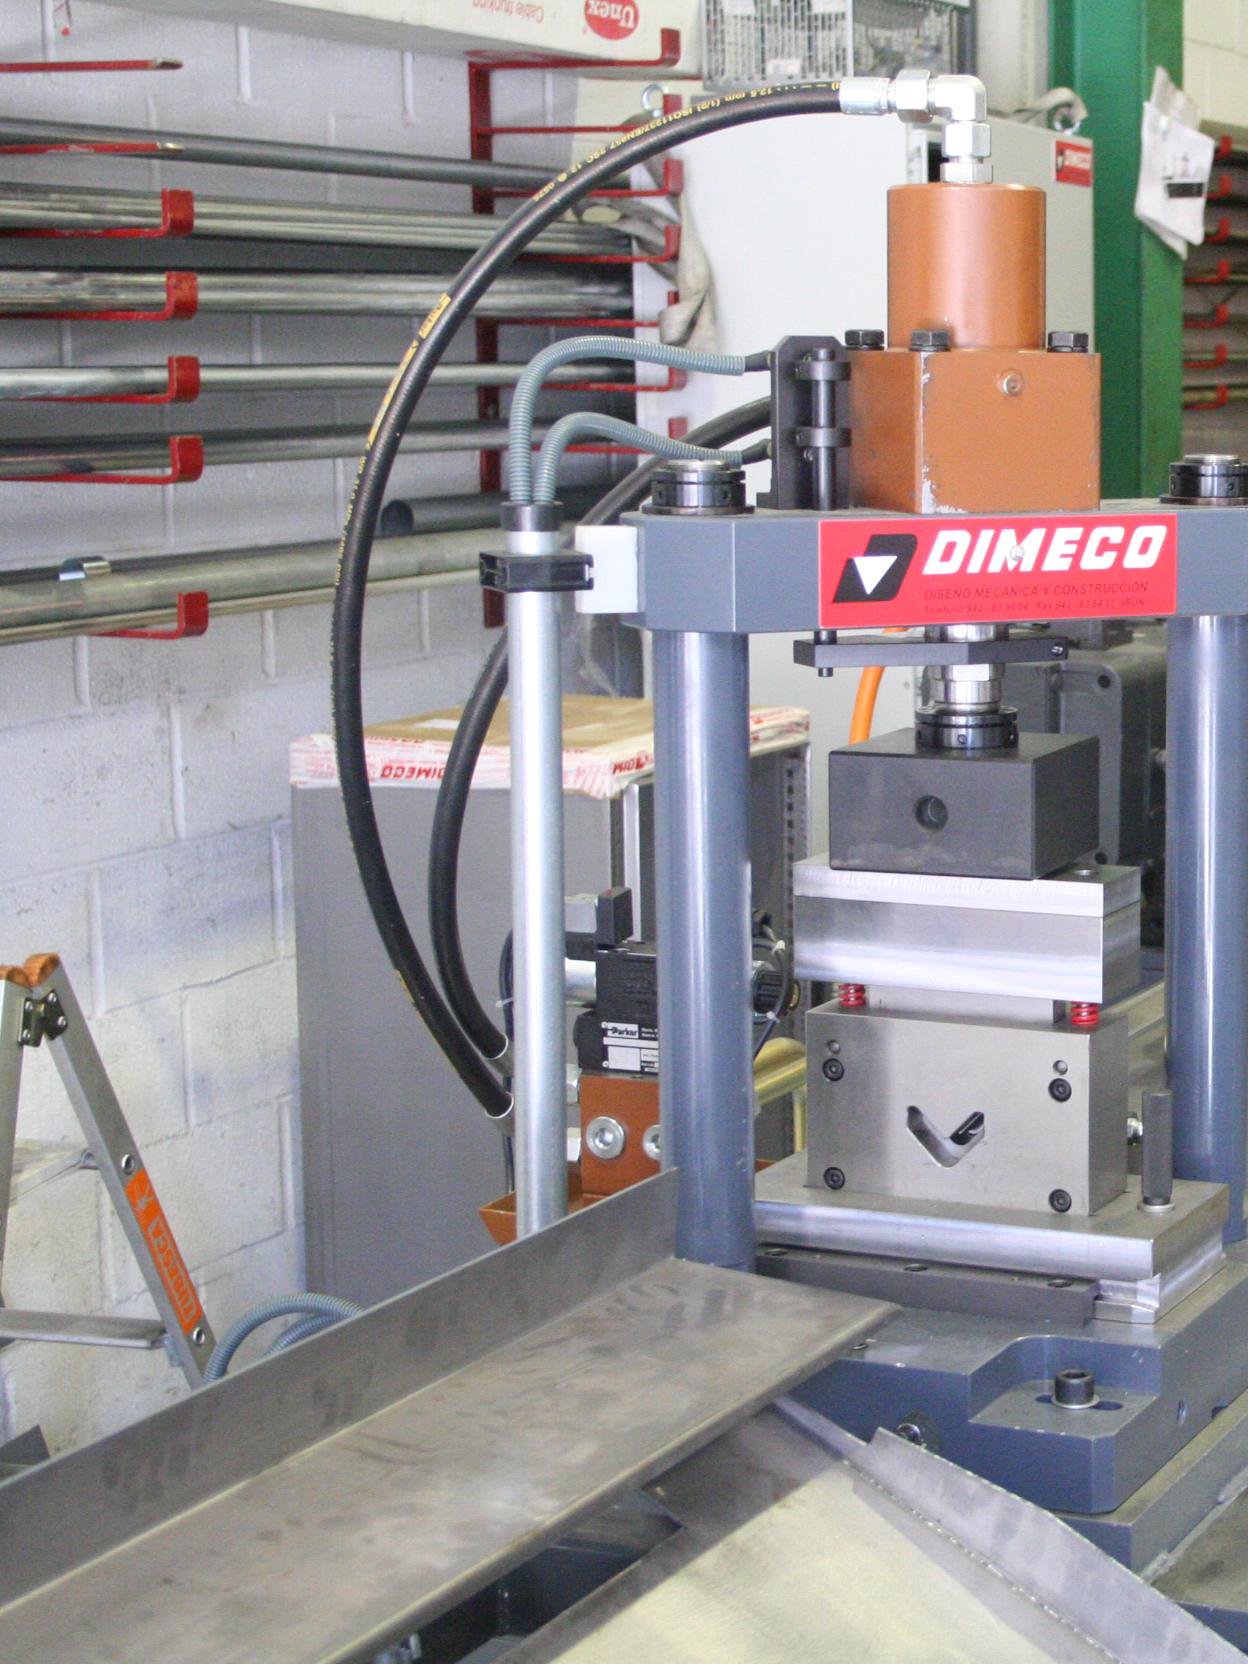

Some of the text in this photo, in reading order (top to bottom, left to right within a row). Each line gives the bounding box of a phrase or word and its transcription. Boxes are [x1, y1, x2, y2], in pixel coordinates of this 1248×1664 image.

[587, 0, 633, 28] Unex
[922, 525, 1167, 575] DIMECO
[381, 764, 445, 779] DIMECO
[610, 1026, 638, 1036] Parker
